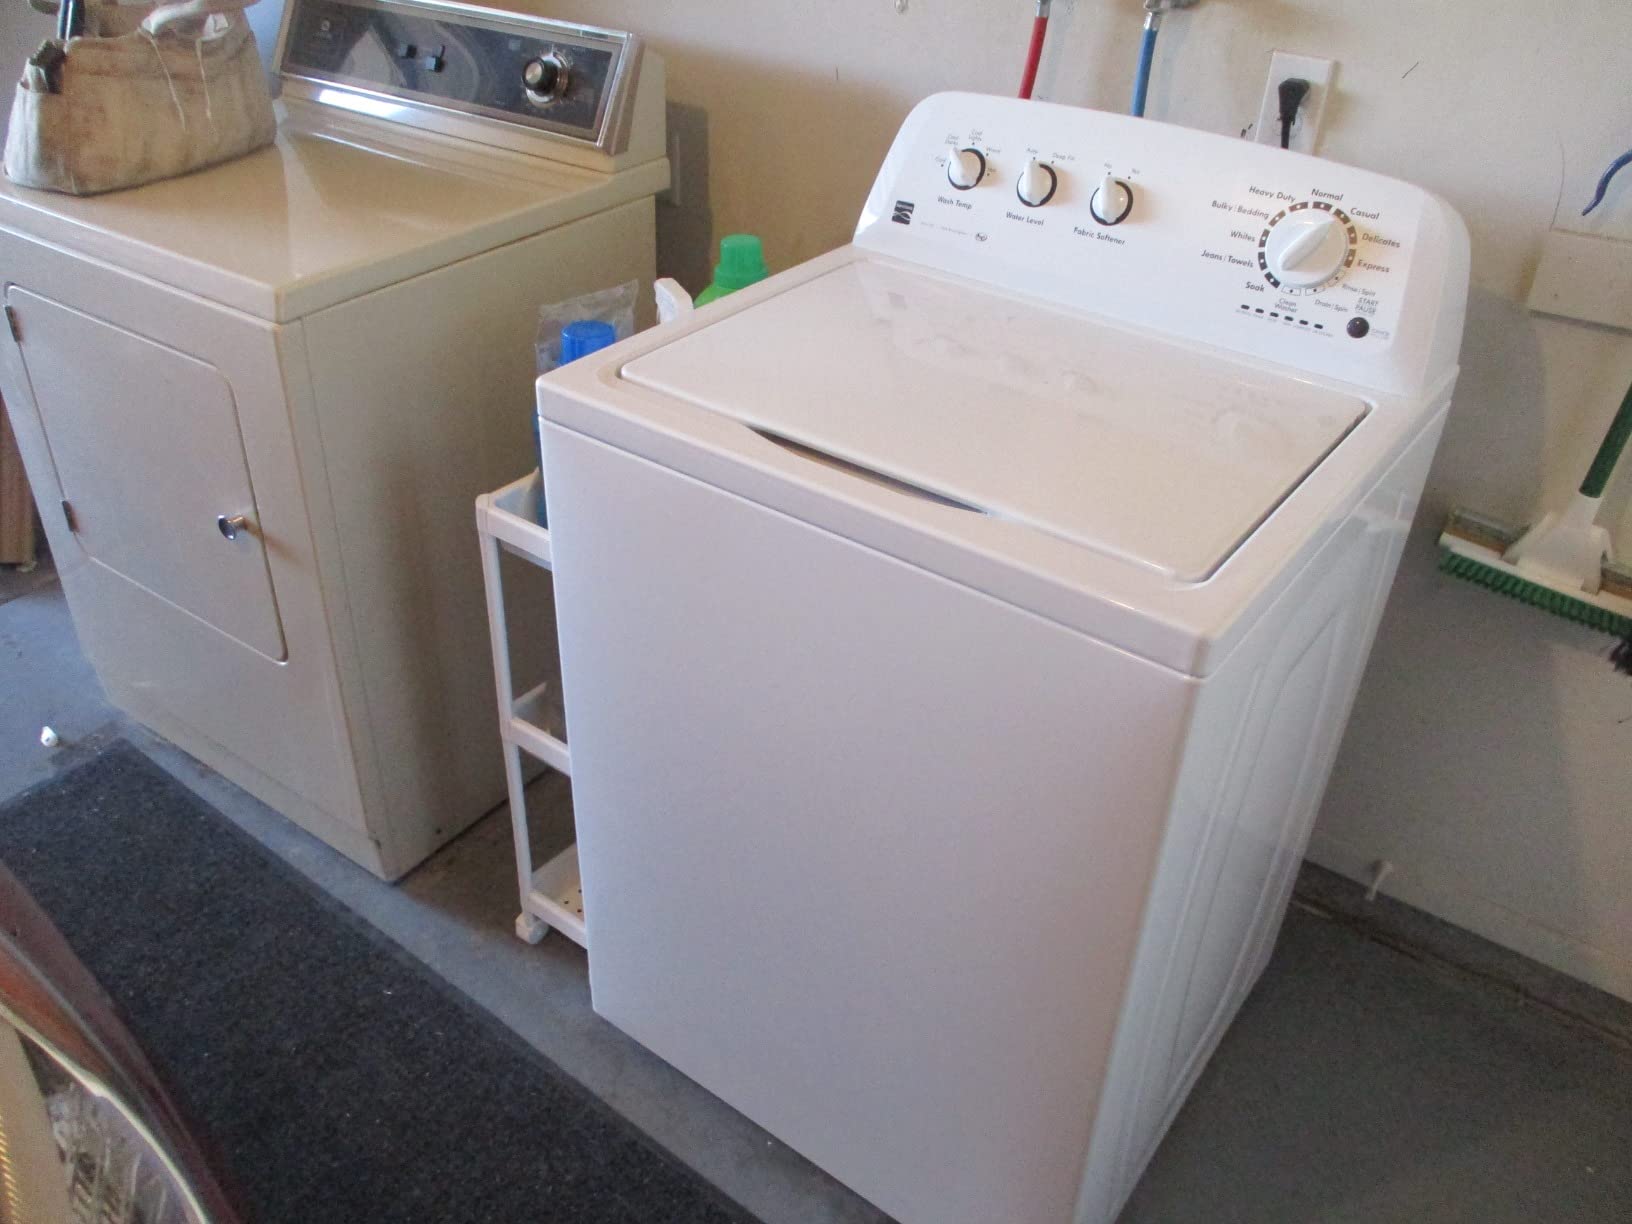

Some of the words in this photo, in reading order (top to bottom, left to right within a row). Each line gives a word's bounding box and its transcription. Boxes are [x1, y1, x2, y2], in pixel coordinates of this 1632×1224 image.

[1249, 185, 1274, 198] Heavy
[1276, 191, 1297, 203] Duty
[1311, 188, 1343, 201] Normal
[937, 196, 954, 206] Wash
[955, 199, 972, 210] Temp
[1212, 200, 1233, 212] Bulky
[1237, 204, 1269, 220] Bedding
[1350, 207, 1380, 220] Casual
[1006, 211, 1025, 221] Water
[1027, 217, 1045, 226] Level
[1074, 227, 1094, 239] Fabric
[1097, 232, 1126, 246] Softener
[1230, 230, 1256, 242] Whites
[1362, 233, 1401, 248] Delicates
[1201, 249, 1223, 261] Jeans
[1227, 255, 1254, 268] Towels
[1357, 259, 1390, 273] Express
[1245, 281, 1265, 293] Soak
[1279, 298, 1297, 307] Clean
[1358, 297, 1379, 306] START
[1275, 303, 1299, 314] Washer
[1354, 305, 1376, 314] PAUSE
